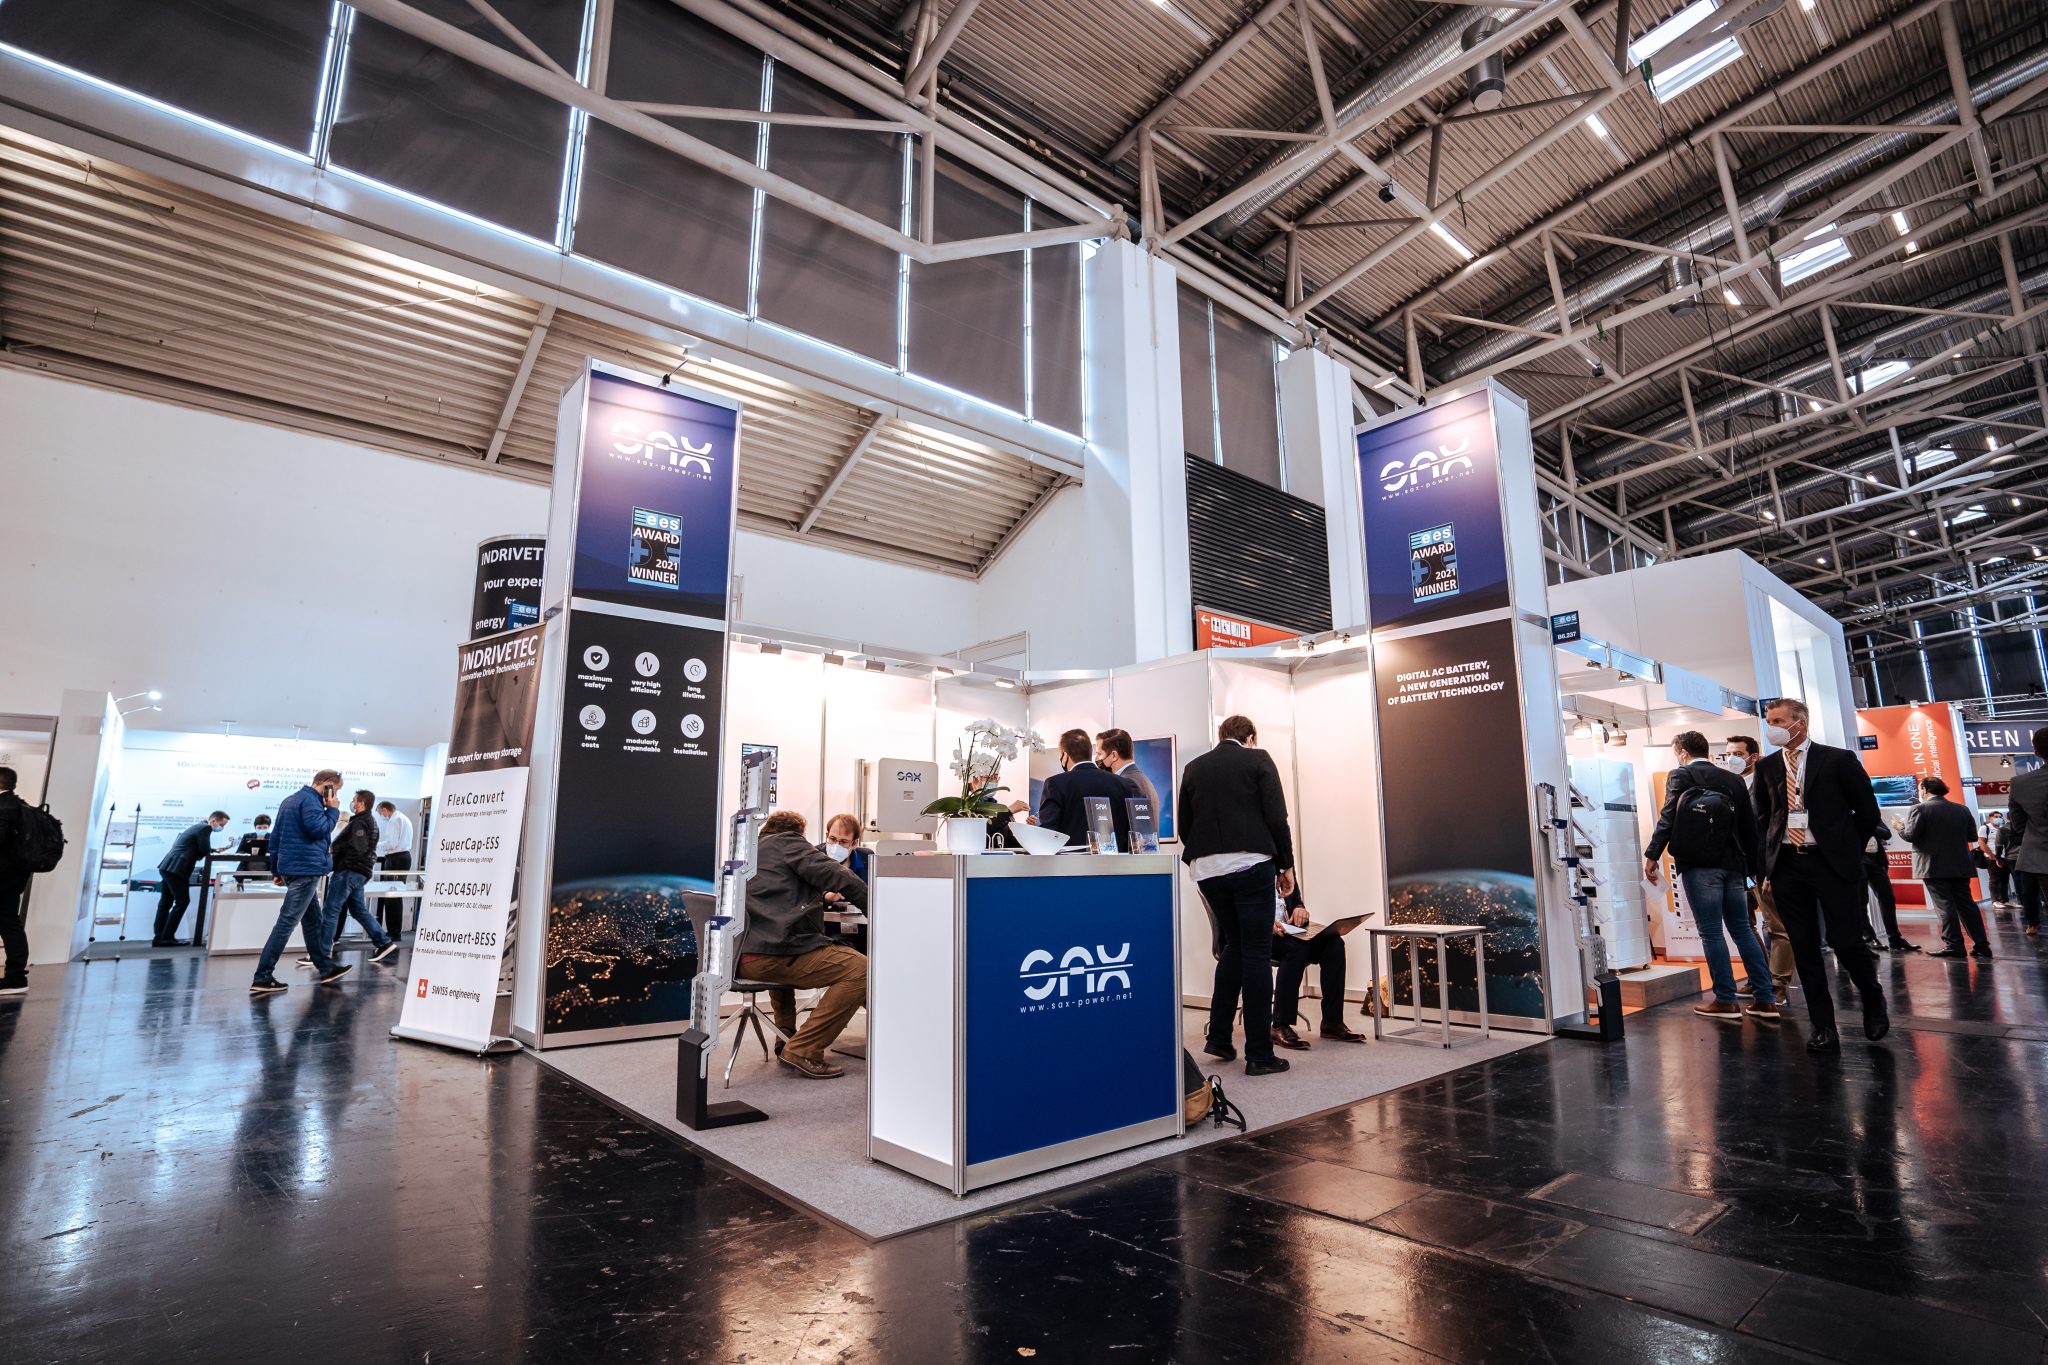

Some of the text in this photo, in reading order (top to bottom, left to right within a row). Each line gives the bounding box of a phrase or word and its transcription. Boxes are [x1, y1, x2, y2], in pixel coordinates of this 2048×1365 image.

[610, 420, 714, 473] SAX
[1380, 437, 1474, 491] SAX
[646, 515, 680, 531] ees
[633, 527, 679, 545] AWARD
[1421, 528, 1452, 544] ees
[481, 547, 543, 566] INDRIVET
[1412, 542, 1454, 561] AWARD
[655, 558, 678, 571] 2021
[631, 566, 677, 584] WINNER
[1435, 568, 1456, 581] 2021
[483, 577, 543, 592] your exper
[1415, 579, 1457, 597] WINNER
[475, 617, 506, 630] energy
[462, 635, 538, 673] INDRIVETEC
[460, 658, 535, 682] Innovative Drive Technologies AG
[578, 674, 613, 683] maximum
[1396, 660, 1490, 682] DIGITAL AC BATTERY,
[584, 682, 605, 690] safety
[646, 681, 661, 689] high
[687, 685, 701, 693] long
[1399, 671, 1490, 693] A NEW GENERATION
[630, 687, 661, 696] efficiency
[682, 692, 706, 700] lifetime
[1387, 681, 1505, 705] OF BATTERY TECHNOLOGY
[625, 738, 659, 746] modularly
[1908, 723, 1923, 749] ONE
[1965, 729, 2020, 748] REEN
[448, 747, 522, 764] our expert for energy storage
[623, 745, 661, 753] expandable
[673, 748, 708, 756] installation
[1913, 752, 1926, 764] IN
[897, 771, 922, 782] SAX
[447, 790, 505, 806] FlexConvert
[440, 836, 500, 853] SuperCap-ESS
[435, 882, 492, 896] FC-DC450-PV
[419, 928, 497, 946] FlexConvert-BESS
[1020, 942, 1134, 1001] SAX
[432, 985, 481, 1003] SWISS engineering
[1019, 992, 1133, 1013] www.sax-power.net
